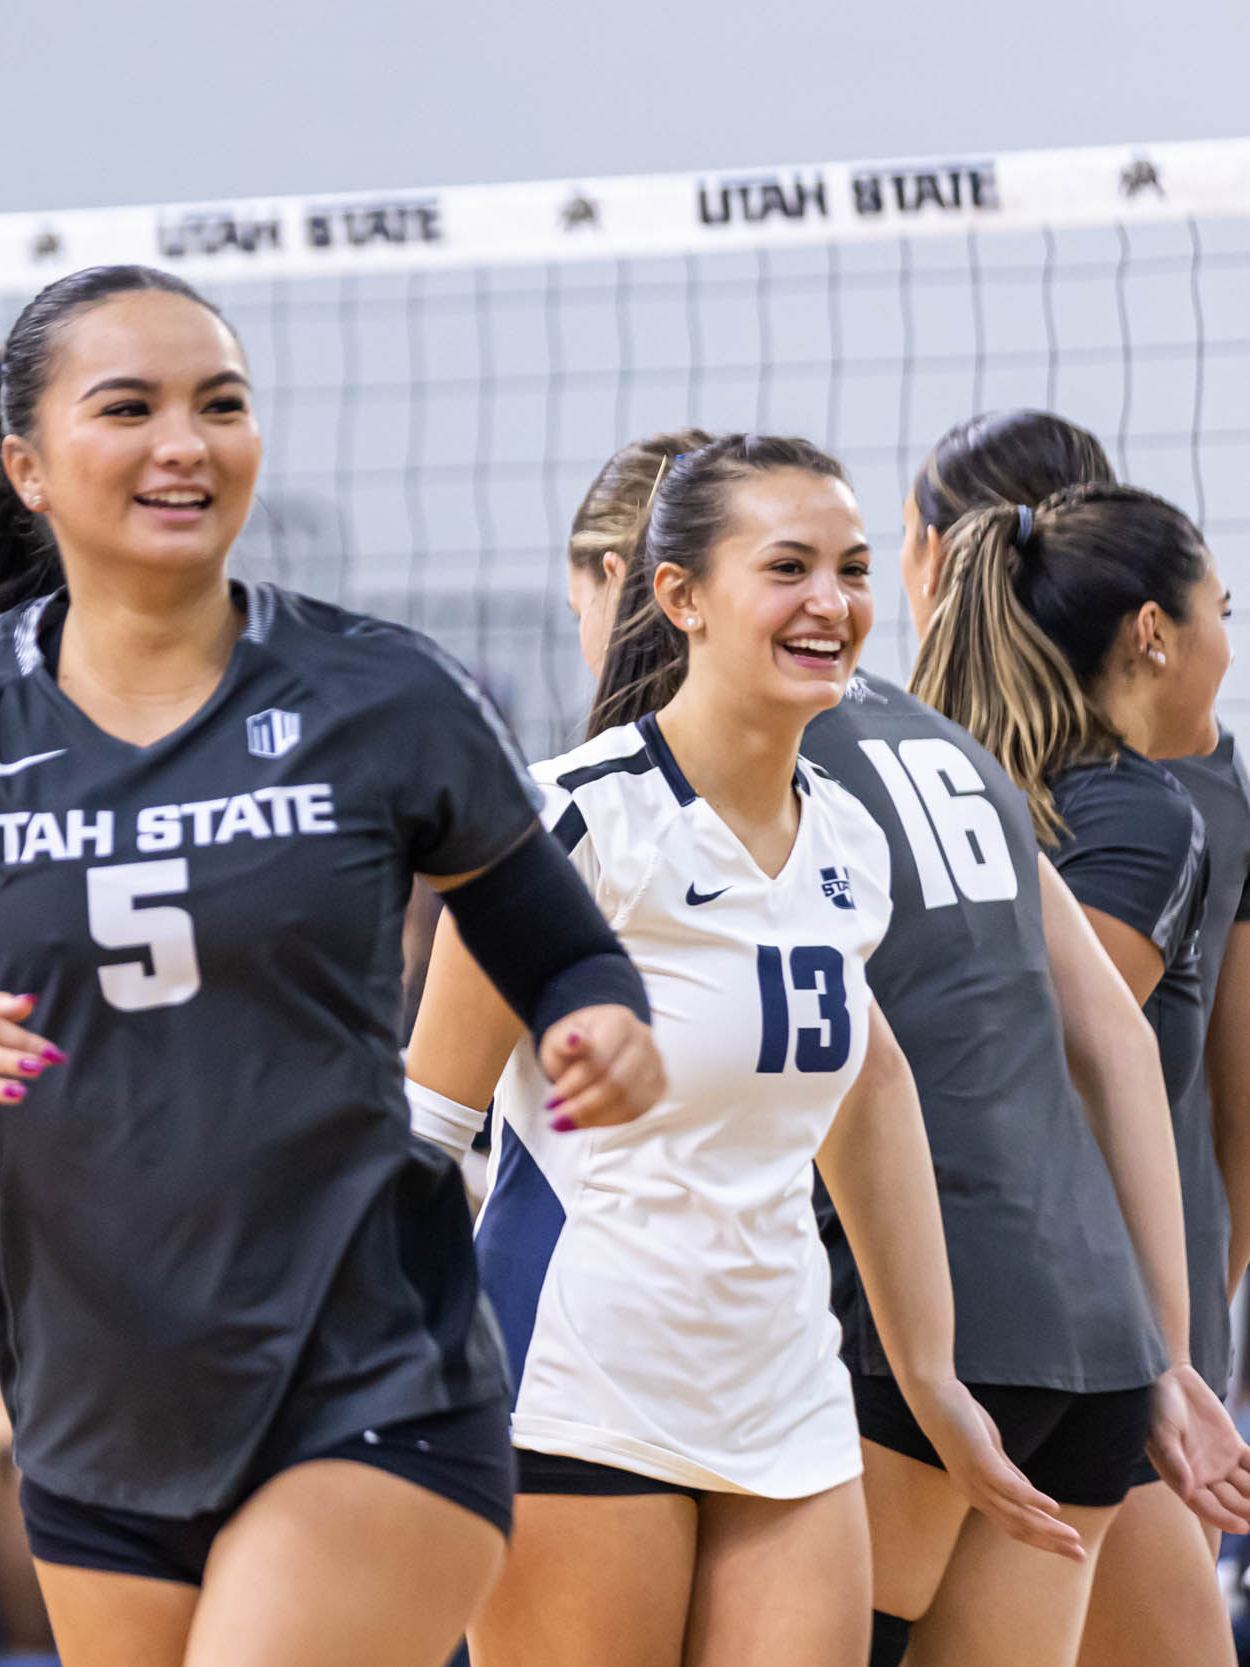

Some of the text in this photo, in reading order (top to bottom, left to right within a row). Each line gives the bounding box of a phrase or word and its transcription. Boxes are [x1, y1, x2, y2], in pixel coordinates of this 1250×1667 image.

[157, 206, 441, 257] UTAH STATE
[699, 168, 1000, 223] UTAH STATE
[137, 783, 338, 853] STATE
[858, 738, 1018, 910] 16
[86, 857, 202, 1013] 5
[755, 944, 851, 1074] 13
